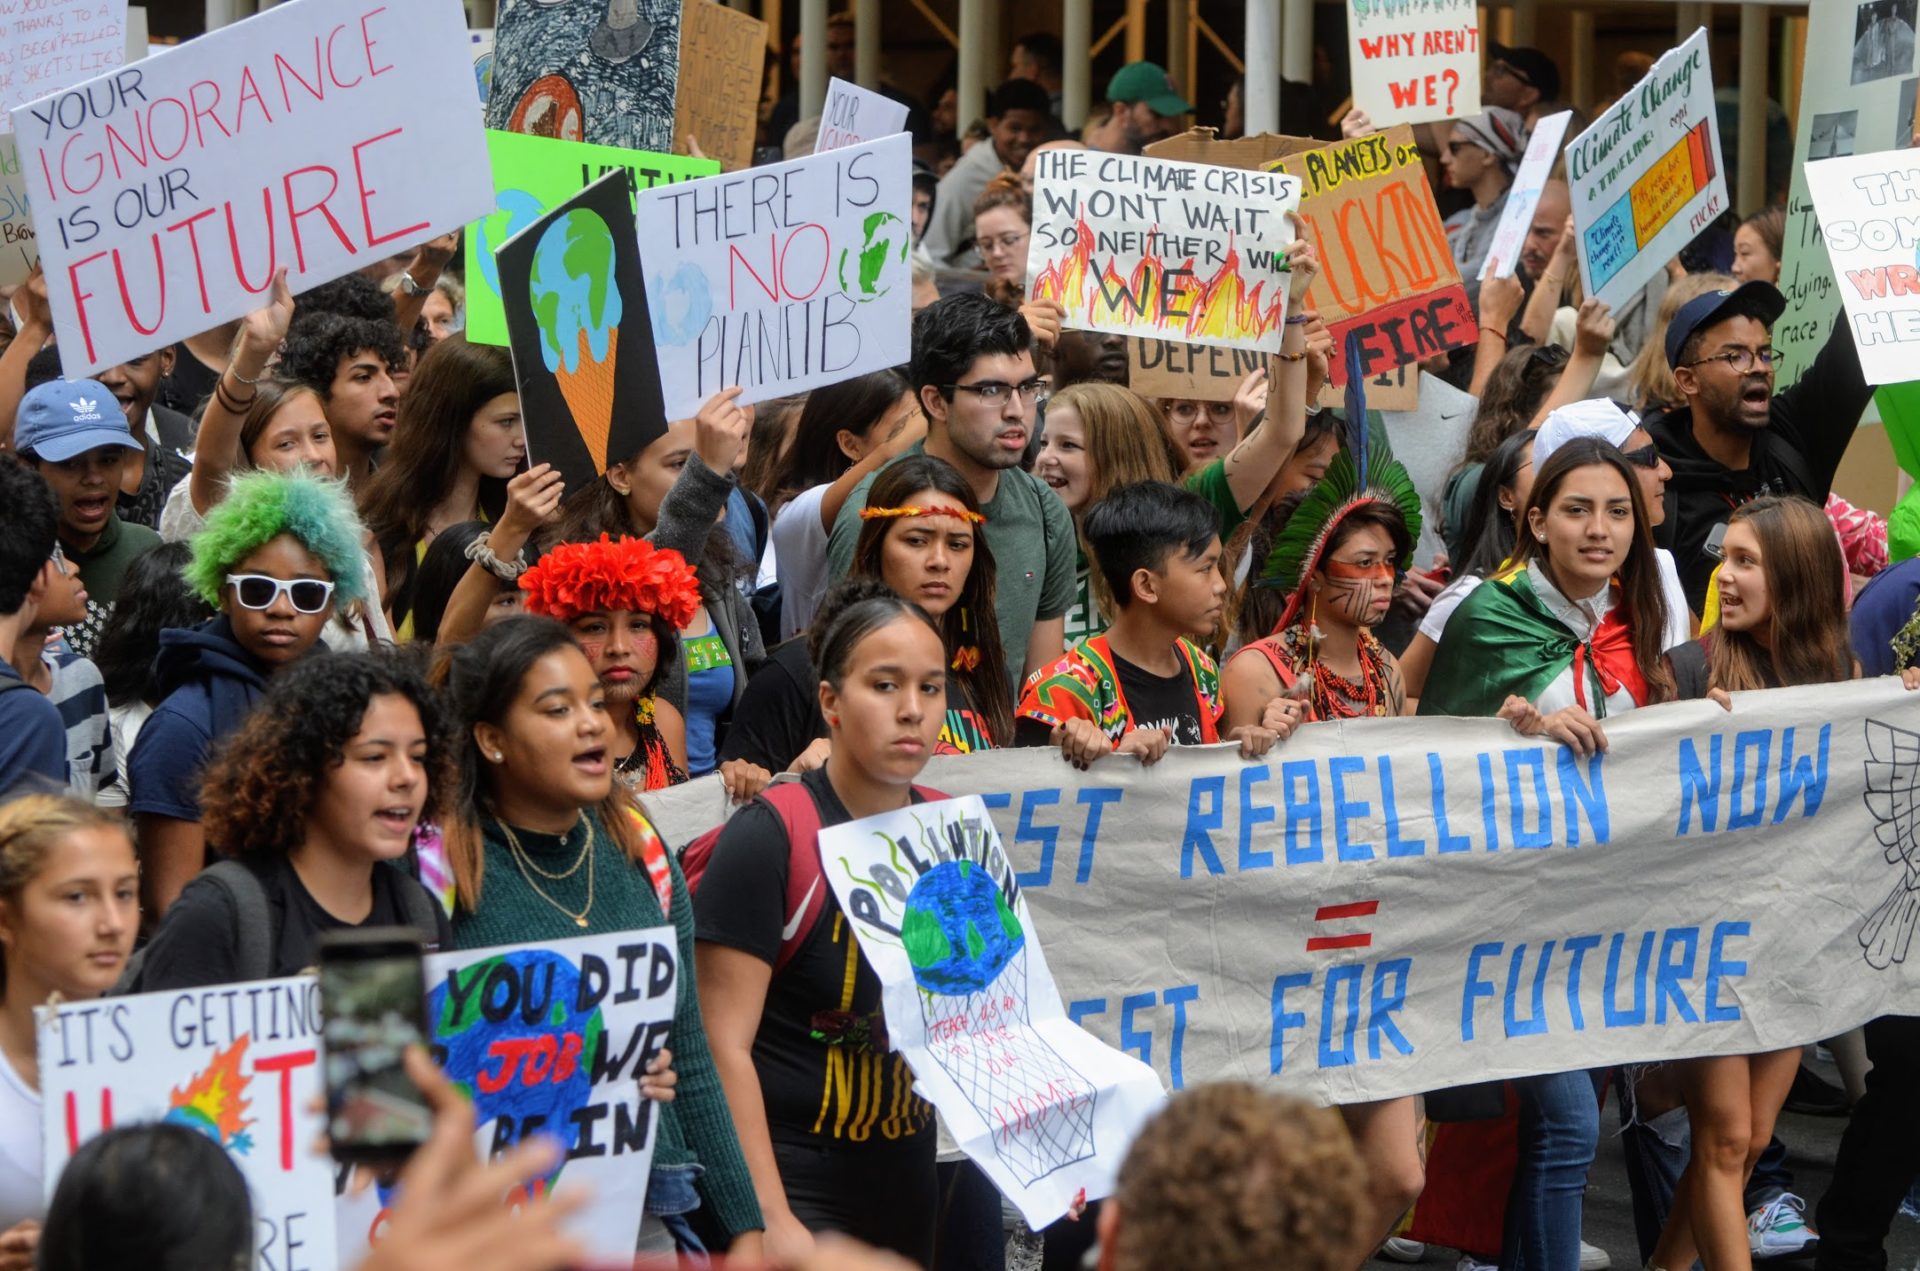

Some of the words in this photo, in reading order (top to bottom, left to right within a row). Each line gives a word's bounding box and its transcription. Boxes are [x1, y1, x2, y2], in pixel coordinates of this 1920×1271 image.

[72, 8, 91, 23] TO
[98, 3, 109, 17] A
[1358, 32, 1415, 60] WHY
[1423, 24, 1479, 56] AREN'T
[21, 39, 57, 60] BEEN
[79, 46, 124, 71] LIES
[31, 69, 147, 141] YOUR
[39, 6, 394, 201] IGNORANCE
[829, 90, 860, 132] YOUR
[1388, 68, 1459, 116] WE?
[1571, 99, 1635, 187] Climate
[1638, 49, 1702, 124] Change
[1037, 151, 1087, 181] THE
[1099, 157, 1197, 191] CLIMATE
[1204, 169, 1292, 201] CRISIS
[1305, 135, 1393, 193] PLANETS
[59, 205, 100, 250] IS
[113, 168, 199, 229] OUR
[657, 168, 806, 250] THERE
[836, 152, 879, 218] IS
[1182, 197, 1270, 242] WAIT,
[1689, 195, 1720, 235] FUCK!
[67, 127, 431, 365] FUTURE
[729, 223, 830, 311] NO
[1037, 222, 1079, 249] SO
[1098, 229, 1227, 266] NEITHER
[1784, 260, 1832, 312] dying.
[820, 290, 861, 373] B
[1781, 320, 1818, 347] race
[73, 413, 101, 422] adidas
[1180, 744, 1610, 880] REBELLION
[1677, 722, 1831, 837] NOW
[849, 817, 1019, 938] POLLUTION
[447, 960, 557, 1028] YOU
[575, 941, 676, 1014] DID
[1270, 957, 1415, 1075] FOR
[1461, 920, 1751, 1041] FUTURE
[57, 1003, 135, 1068] IT'S
[170, 982, 324, 1051] GETTING
[928, 1012, 969, 1043] TEACH
[981, 999, 997, 1021] US
[476, 1032, 583, 1094] JOB
[590, 1019, 674, 1087] WE
[566, 1099, 651, 1159] IN
[994, 1077, 1089, 1146] HOME
